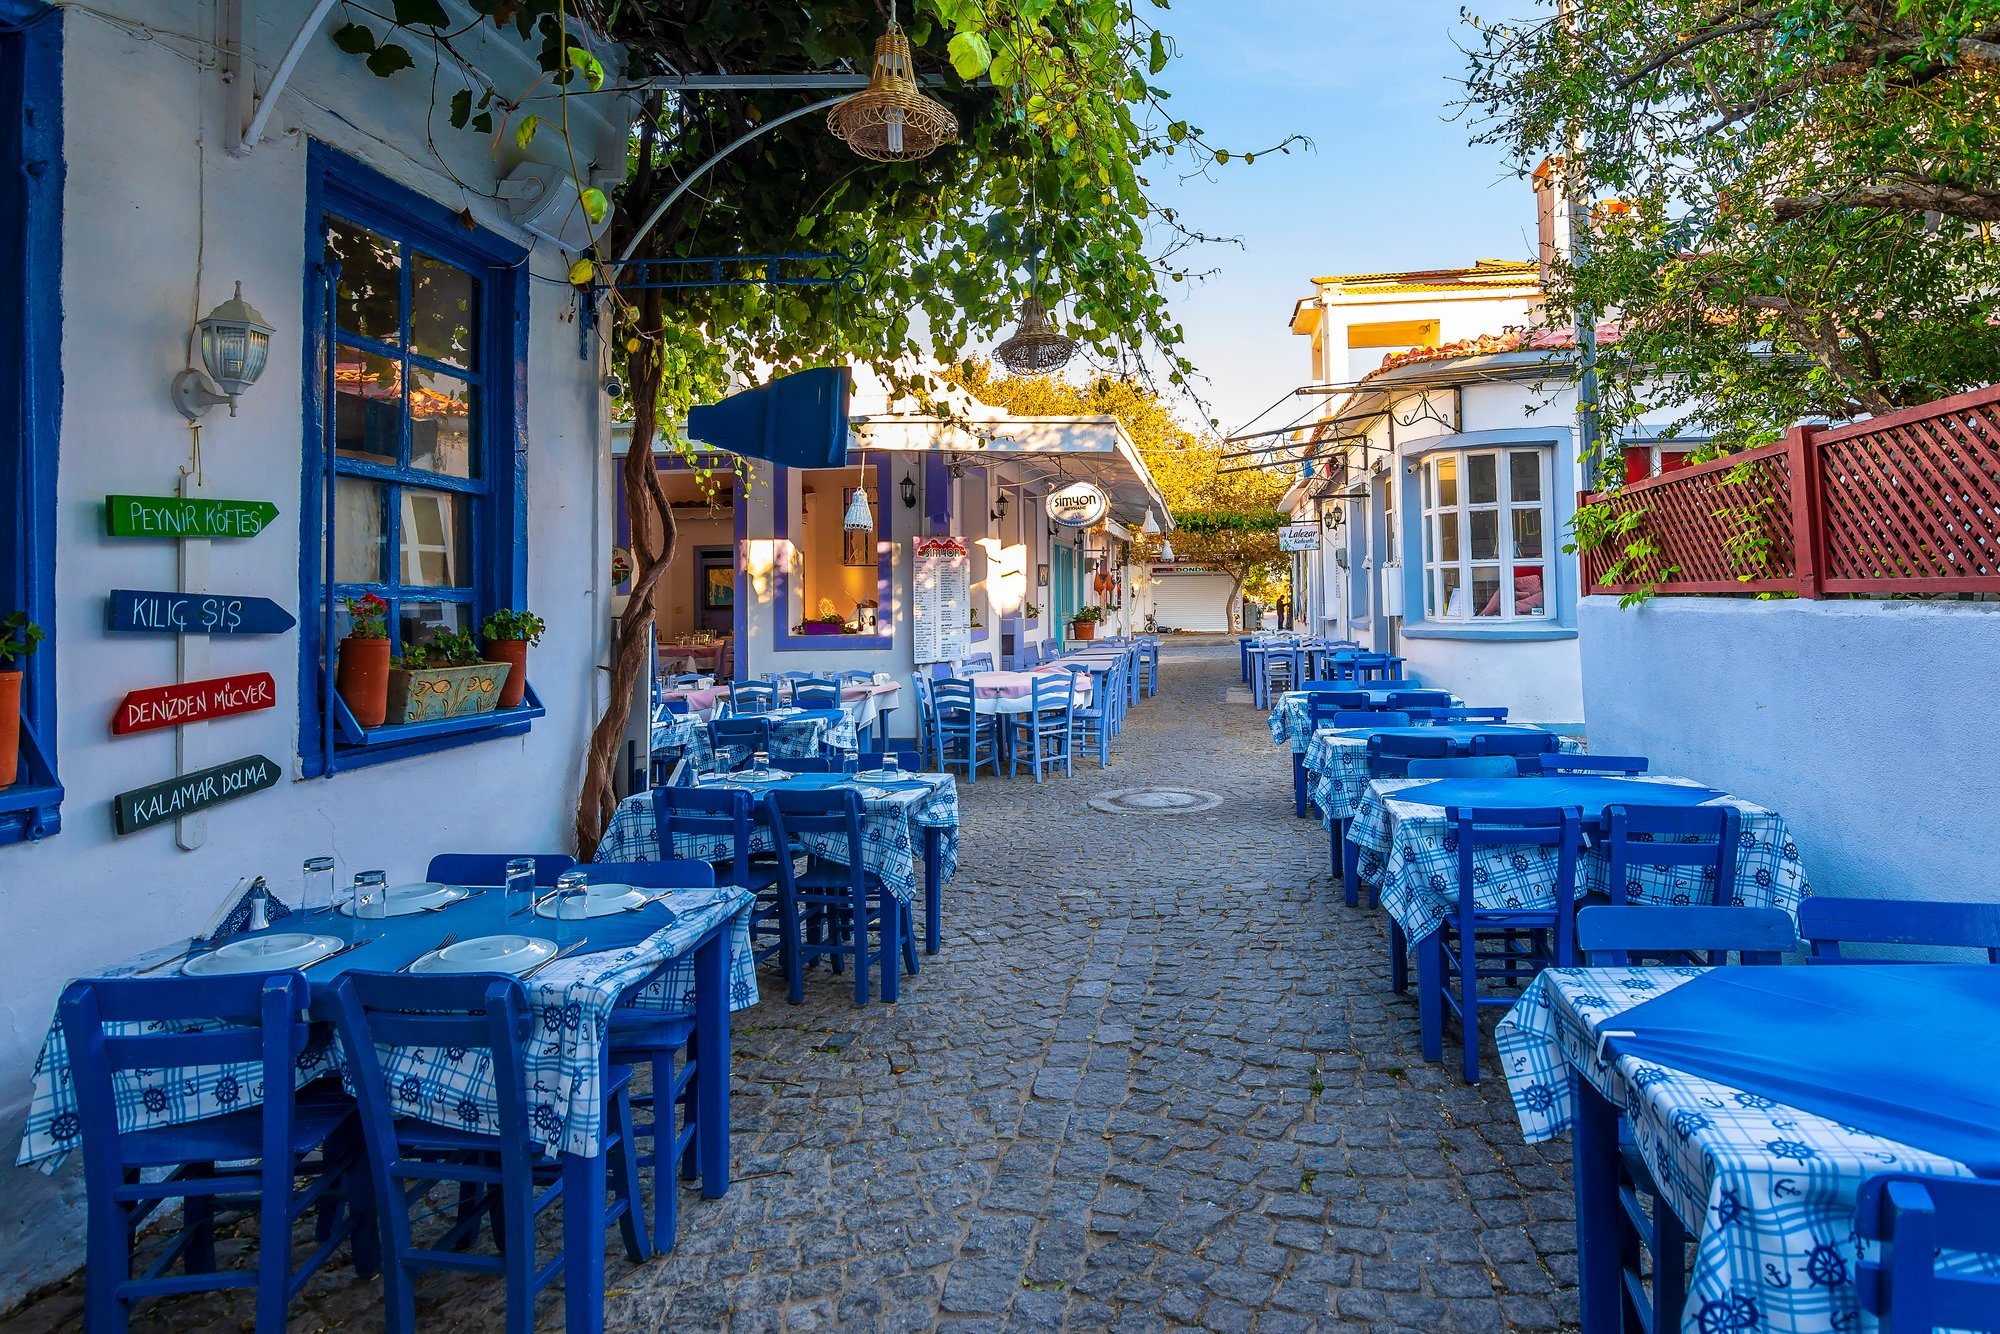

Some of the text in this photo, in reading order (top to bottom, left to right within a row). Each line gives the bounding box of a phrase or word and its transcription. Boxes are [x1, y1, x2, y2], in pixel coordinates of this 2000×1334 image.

[1054, 495, 1096, 507] simyon
[131, 502, 263, 535] PEYNİR KÖFTESİ
[1288, 528, 1318, 538] Lalezar
[133, 598, 242, 633] KILIÇ ŞİŞ
[128, 681, 272, 727] DENİZDEN MÜCVER
[134, 762, 267, 824] KALAMAR DOLMA
